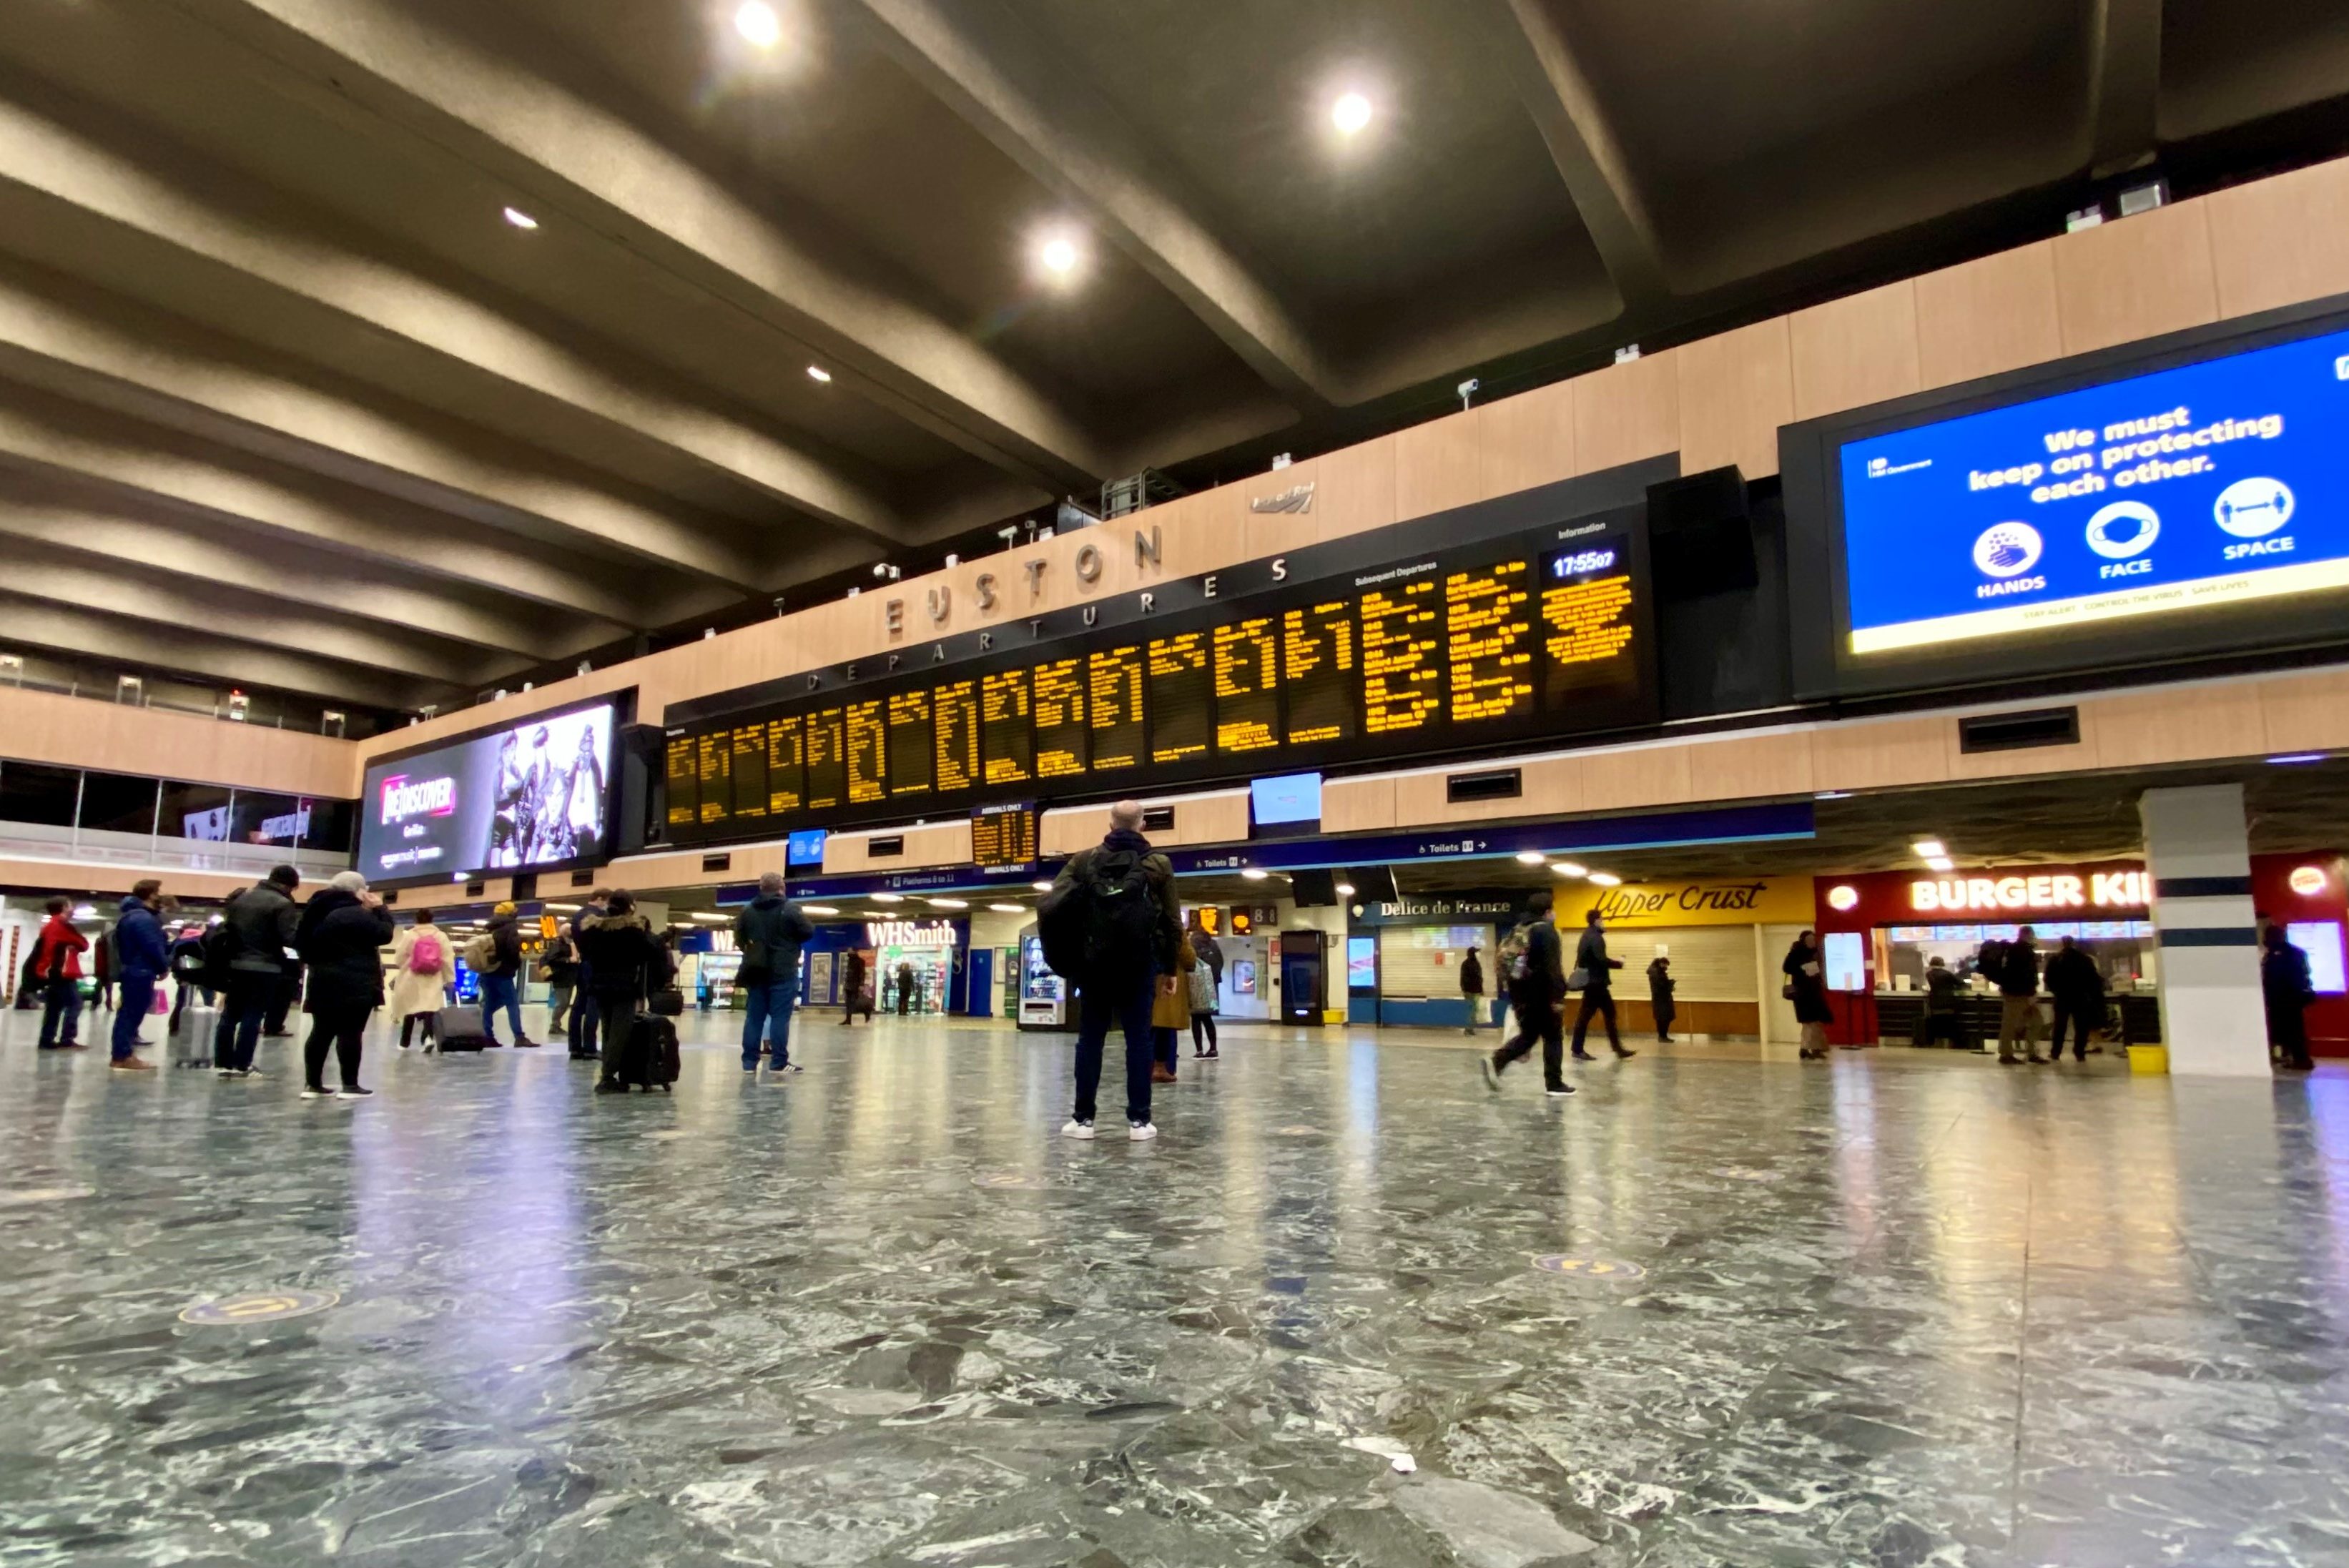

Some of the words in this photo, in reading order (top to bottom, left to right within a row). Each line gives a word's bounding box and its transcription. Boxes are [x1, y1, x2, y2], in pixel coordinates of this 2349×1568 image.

[2044, 426, 2095, 454] We
[2104, 405, 2190, 442] must
[1969, 460, 2043, 492] keep
[2052, 452, 2092, 475] on
[2101, 413, 2283, 470] protecting
[2031, 475, 2104, 503] each
[2113, 451, 2216, 489] other.
[1558, 522, 1606, 539] Information
[2224, 536, 2296, 561] SPACE
[885, 526, 1162, 631] EUSTON
[1355, 571, 1396, 586] Subsequent
[1397, 562, 1437, 577] Departures
[2099, 559, 2154, 580] FACE
[1976, 575, 2047, 599] HANDS
[2023, 610, 2045, 620] STAY
[2048, 604, 2077, 616] ALERT
[2084, 598, 2129, 611] CONTROL
[2132, 593, 2150, 604] THE
[2153, 590, 2183, 601] VIRUS
[2192, 585, 2217, 596] SAVE
[2220, 580, 2250, 591] LIVES
[807, 558, 1286, 691] DEPARTURES
[982, 805, 1007, 815] ARRIVALS
[1007, 803, 1022, 812] ONLY
[1429, 843, 1459, 854] Toilets
[984, 865, 1009, 874] ARRIVALS
[1010, 864, 1025, 872] ONLY
[1204, 859, 1227, 868] Toilets
[1595, 889, 1677, 922] Upper
[1678, 881, 1767, 911] Crust
[1912, 874, 2084, 911] BURGER
[1432, 900, 1451, 914] de
[1455, 900, 1511, 913] France
[867, 919, 957, 947] WHSmith
